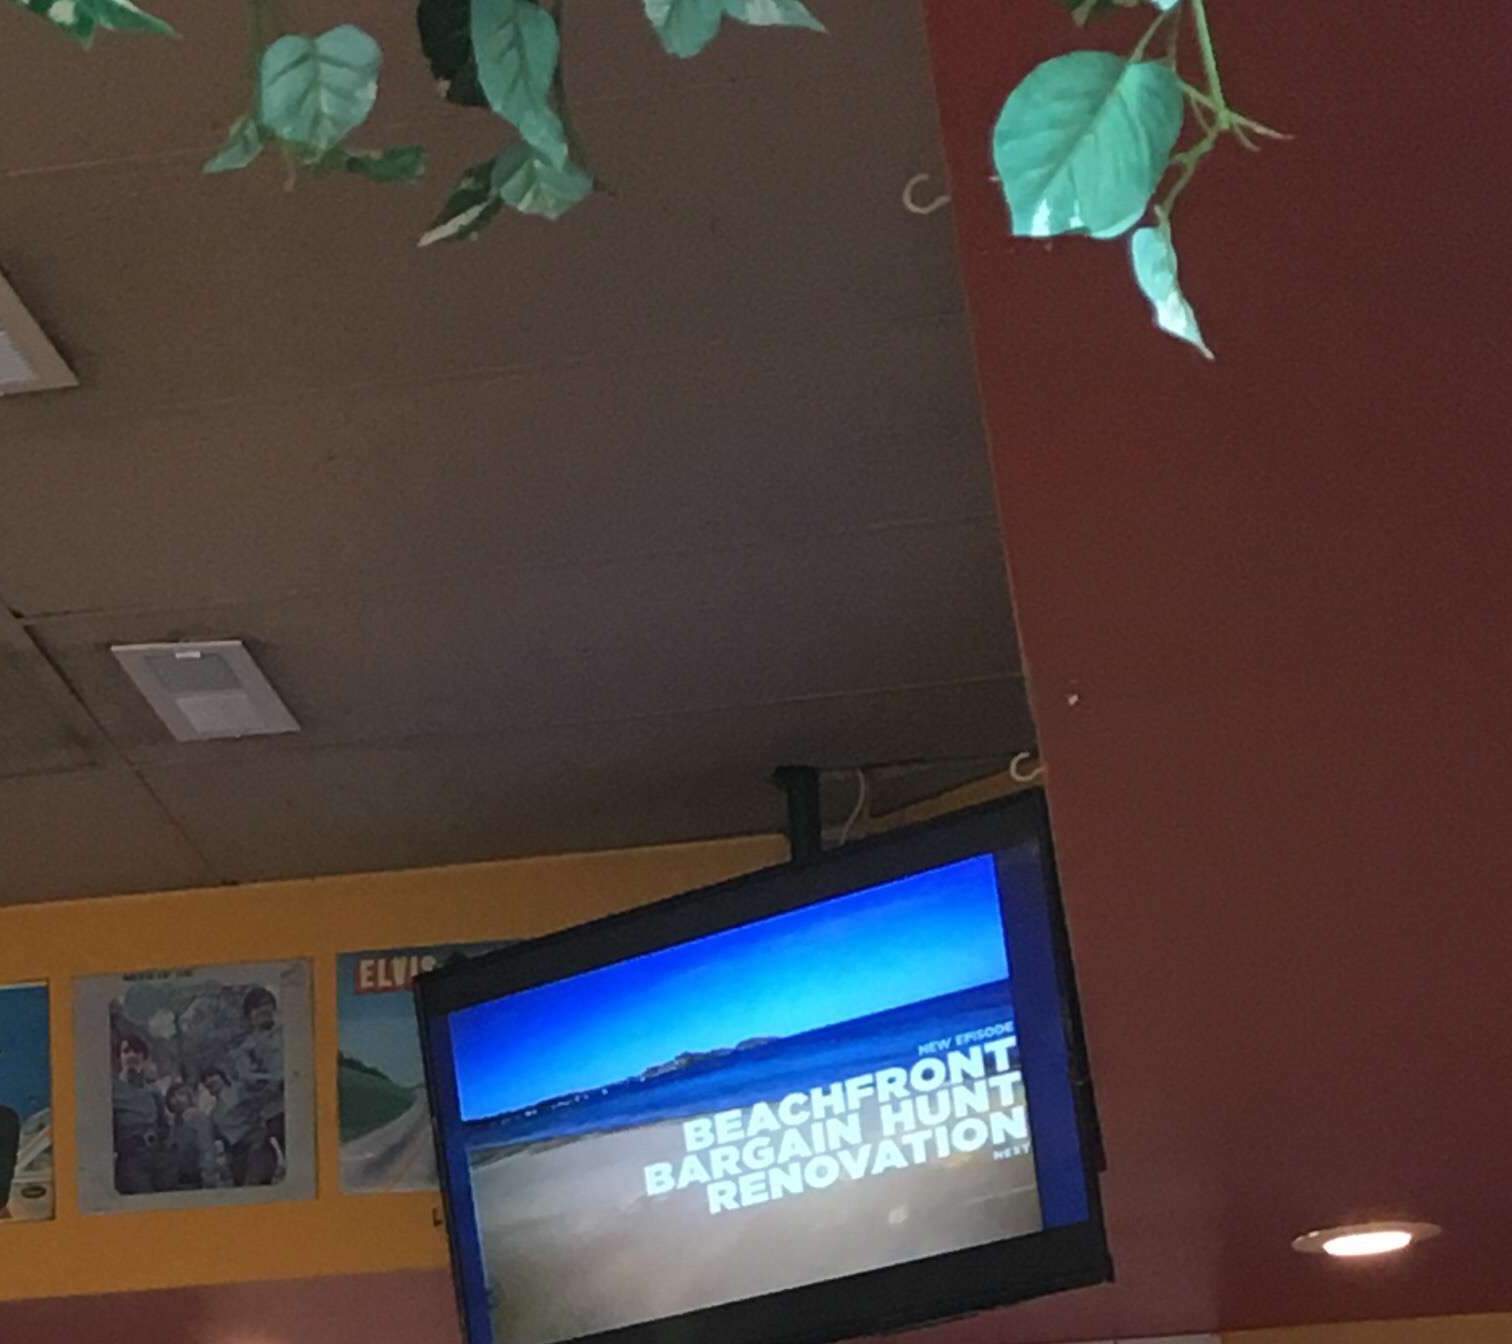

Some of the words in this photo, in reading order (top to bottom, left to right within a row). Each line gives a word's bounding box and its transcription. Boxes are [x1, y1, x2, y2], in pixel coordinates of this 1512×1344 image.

[918, 1037, 951, 1056] NEW
[955, 1020, 1014, 1046] EPISODE
[643, 1112, 863, 1197] BARGAIN
[879, 1069, 1023, 1137] HUNT
[682, 1036, 1017, 1152] BEACHFRONT
[706, 1105, 1029, 1215] RENOVATION
[992, 1143, 1031, 1161] NEXT
